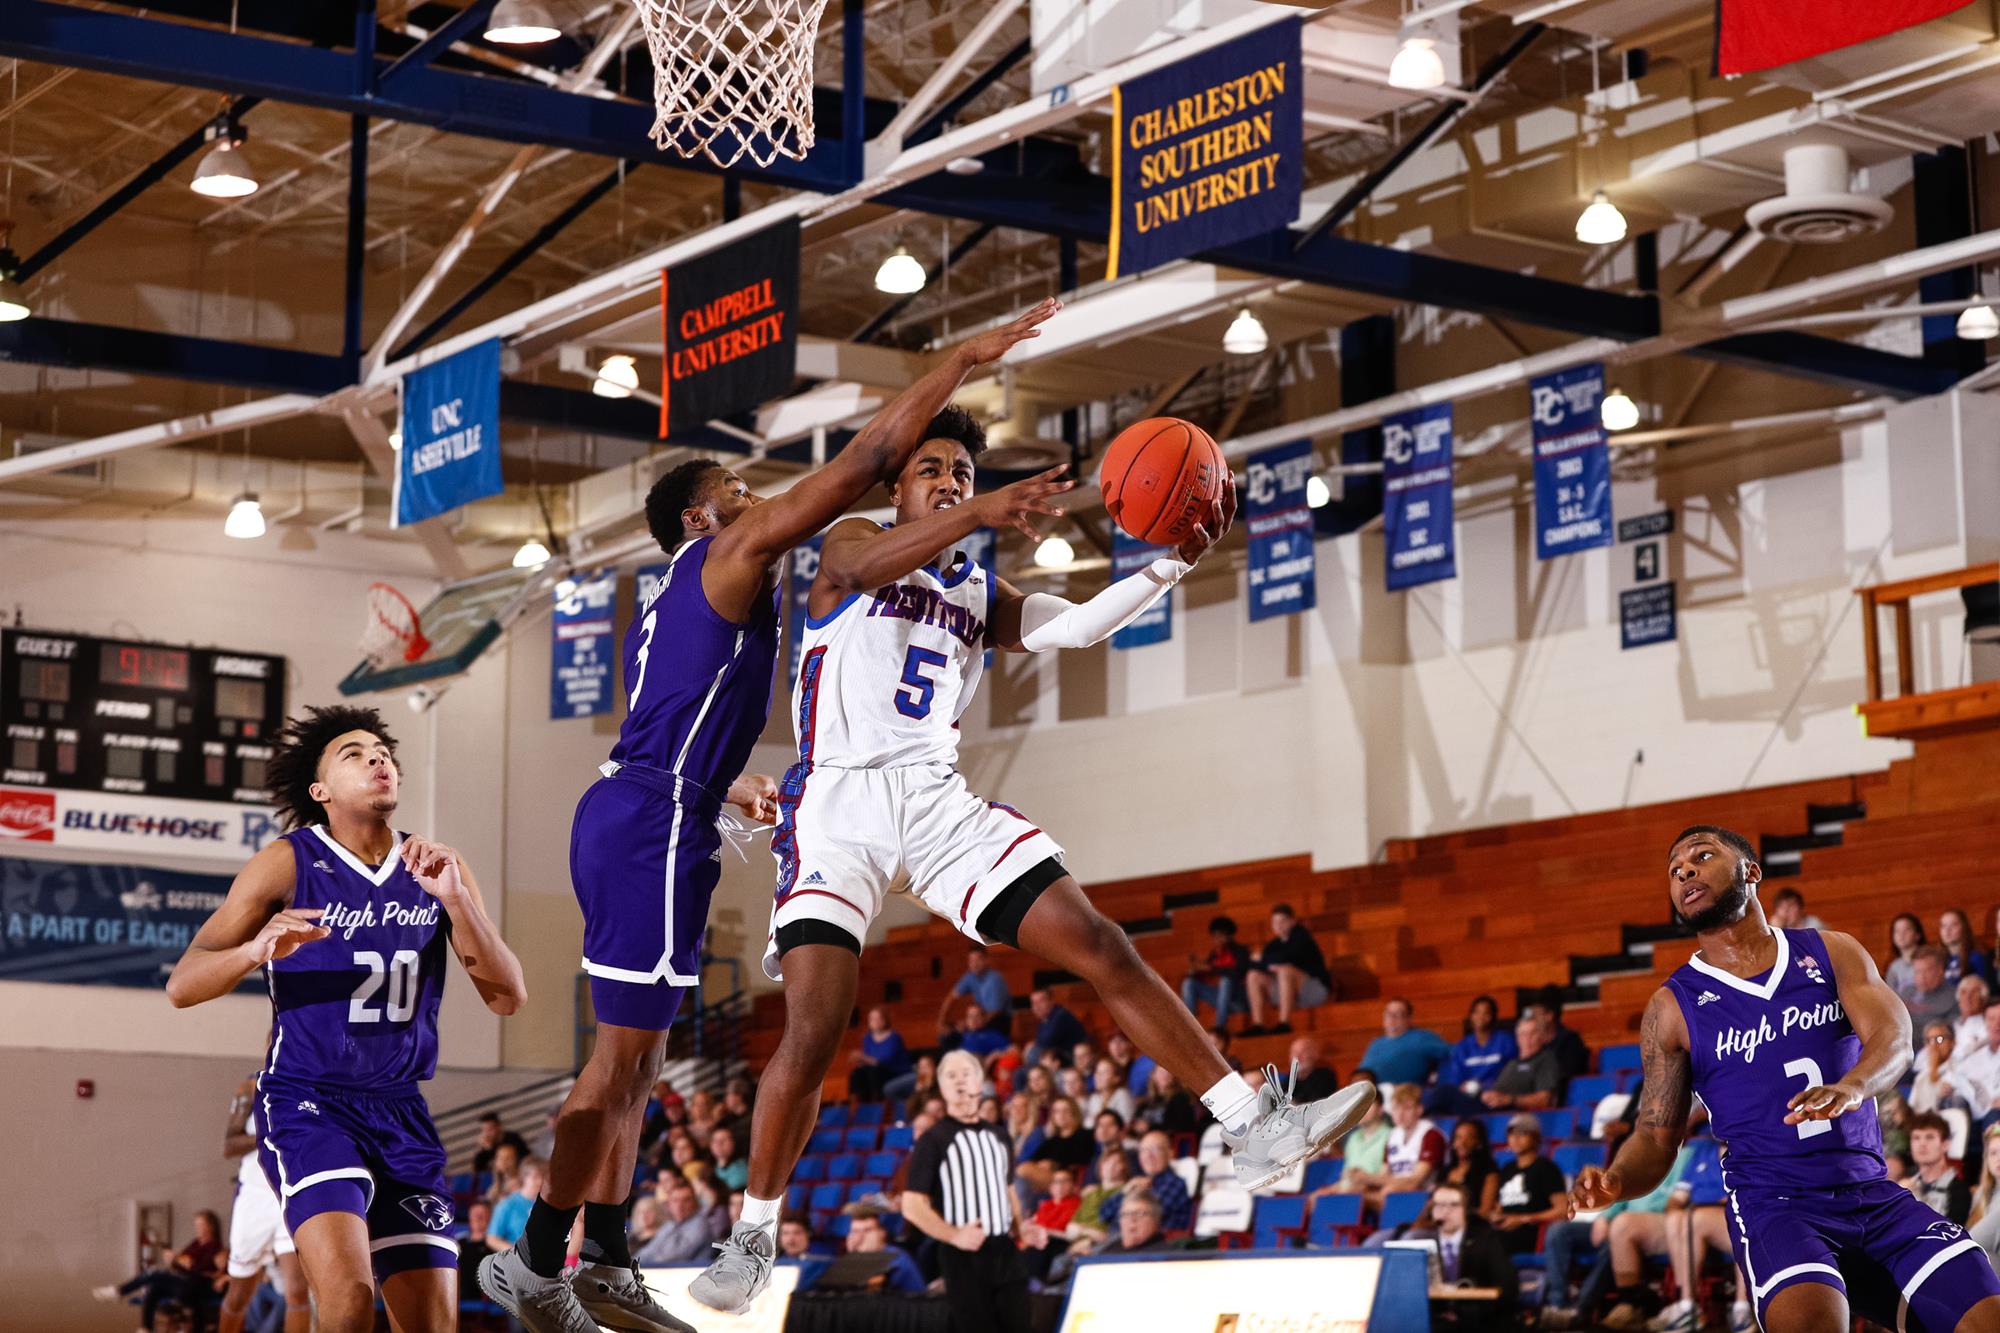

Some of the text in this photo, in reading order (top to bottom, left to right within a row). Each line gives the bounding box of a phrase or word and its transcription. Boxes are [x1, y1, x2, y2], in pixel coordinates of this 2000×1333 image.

[1129, 61, 1286, 149] CHARLESTON
[1139, 110, 1273, 189] SOUTHERN
[1134, 153, 1281, 233] UNIVERSITY
[679, 278, 777, 341] CAMPBELL
[671, 311, 785, 381] UNIVERSITY
[431, 397, 464, 435] UNC
[1532, 385, 1565, 426] PC
[411, 423, 482, 477] ASHEVILLE
[1543, 517, 1602, 547] CHAMPIONS
[1637, 545, 1655, 577] 4
[15, 636, 77, 659] GUEST
[213, 655, 269, 678] HOME
[629, 610, 657, 712] 3
[893, 643, 948, 721] 5
[95, 699, 151, 720] PERIOD
[63, 809, 228, 842] BLUE HOSE
[7, 912, 189, 949] A PART OF EACH
[319, 900, 439, 941] High Point
[347, 949, 420, 1023] 20
[1715, 1014, 1777, 1063] High
[1782, 1057, 1833, 1140] 2
